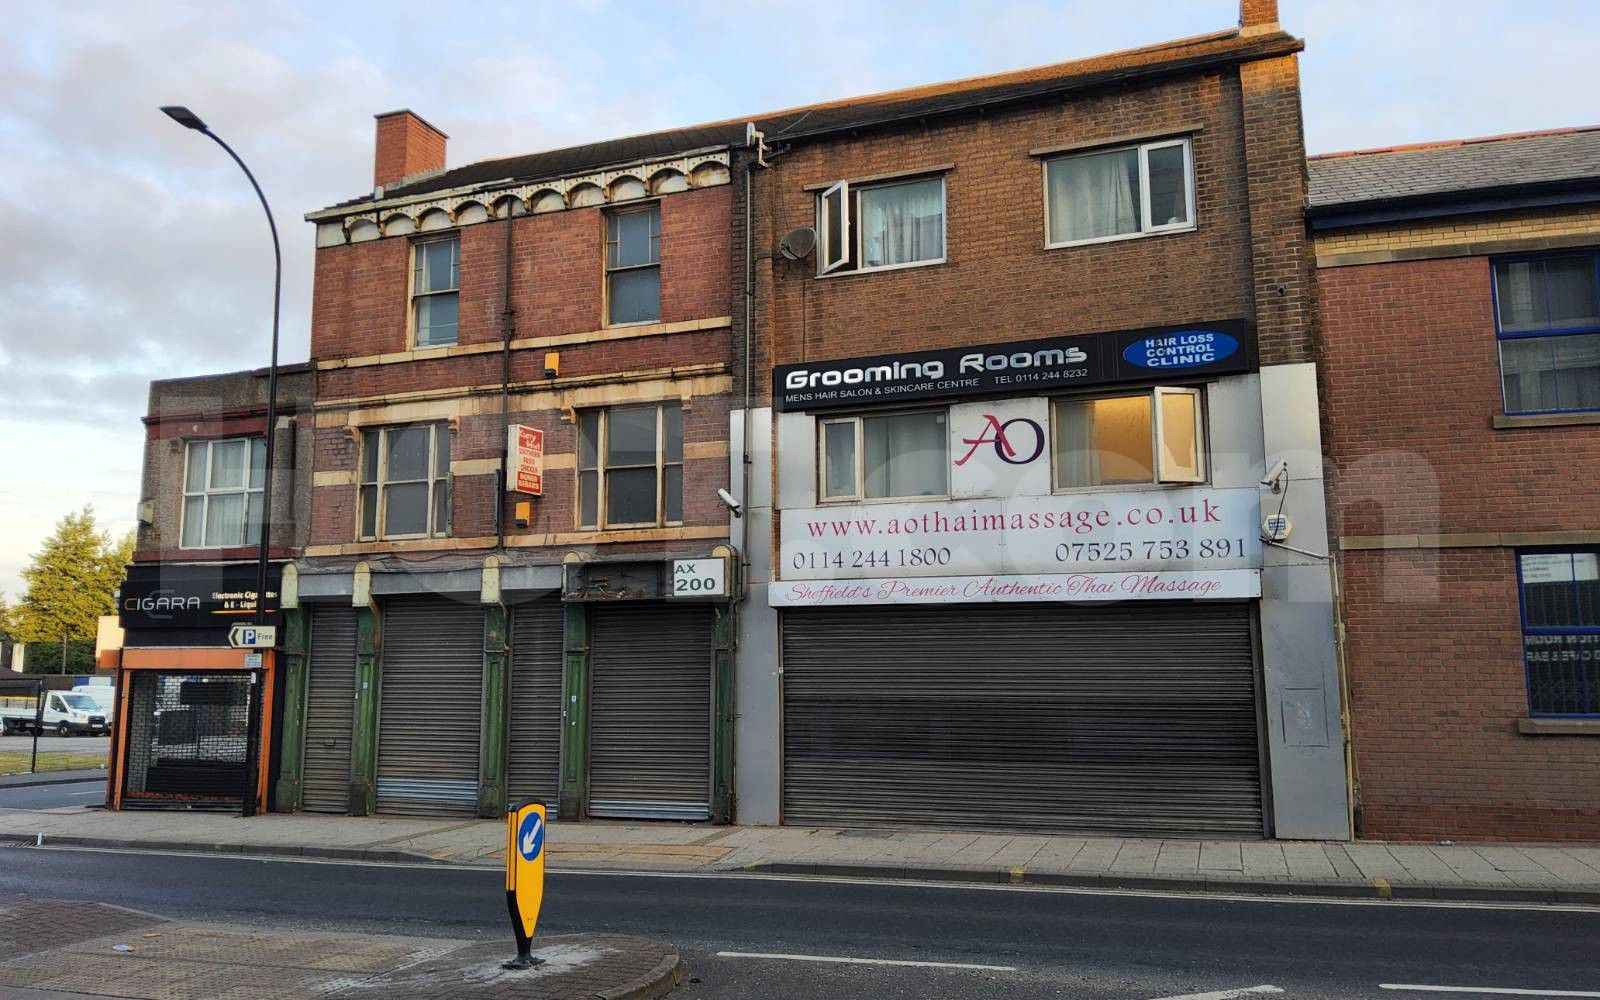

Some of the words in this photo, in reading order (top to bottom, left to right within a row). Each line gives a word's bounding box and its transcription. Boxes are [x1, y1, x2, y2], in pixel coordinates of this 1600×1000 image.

[1145, 337, 1177, 348] HAIR
[1180, 333, 1214, 345] LOSS
[1146, 343, 1215, 357] CONTROL
[1147, 353, 1215, 367] CLINIC
[785, 360, 945, 390] Grooming
[960, 346, 1088, 374] Rooms
[785, 393, 813, 402] MENS
[815, 391, 838, 400] HAIR
[840, 388, 873, 398] SALON
[875, 387, 882, 395] &
[884, 382, 934, 394] SKINCARE
[937, 378, 980, 390] CENTRE
[994, 375, 1013, 384] TEL
[1016, 373, 1039, 383] 0114
[1042, 371, 1060, 380] 244
[1063, 368, 1088, 378] 8232
[954, 414, 1045, 466] AO
[808, 498, 1221, 537] www.aothaimassage.co.uk
[793, 550, 844, 569] 0114
[852, 548, 889, 568] 244
[898, 547, 951, 567] 1800
[1055, 542, 1133, 562] 07525
[1142, 539, 1189, 560] 753
[1200, 538, 1247, 559] 891
[675, 564, 696, 574] AX
[675, 578, 715, 591] 200
[784, 583, 873, 604] Sheffield's
[877, 580, 956, 600] Premier
[963, 577, 1062, 599] Authentic
[1066, 574, 1117, 596] Thai
[1120, 575, 1223, 597] Massage
[212, 591, 244, 599] Electronic
[244, 591, 278, 600] Cigattes
[124, 596, 200, 611] CIGARA
[240, 600, 257, 609] Liqui
[244, 630, 255, 644] P
[257, 633, 273, 641] Free
